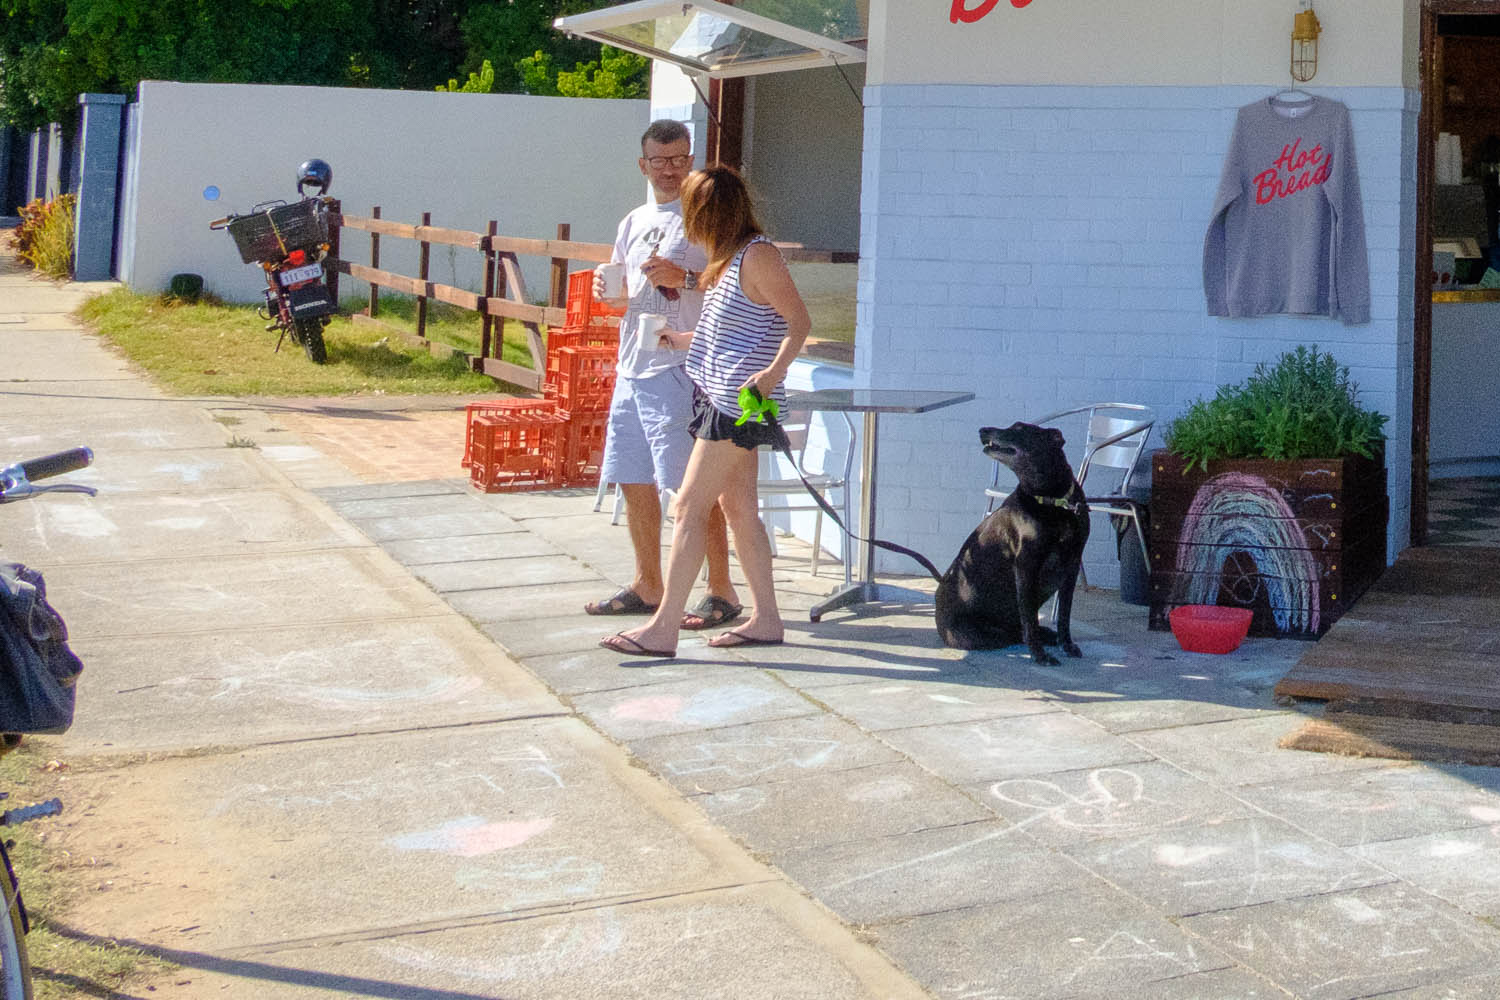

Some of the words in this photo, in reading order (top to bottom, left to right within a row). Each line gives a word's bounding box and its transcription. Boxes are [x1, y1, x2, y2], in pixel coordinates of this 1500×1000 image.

[1273, 137, 1323, 172] Hot
[1254, 153, 1332, 204] Bread
[295, 300, 327, 311] HONDA
